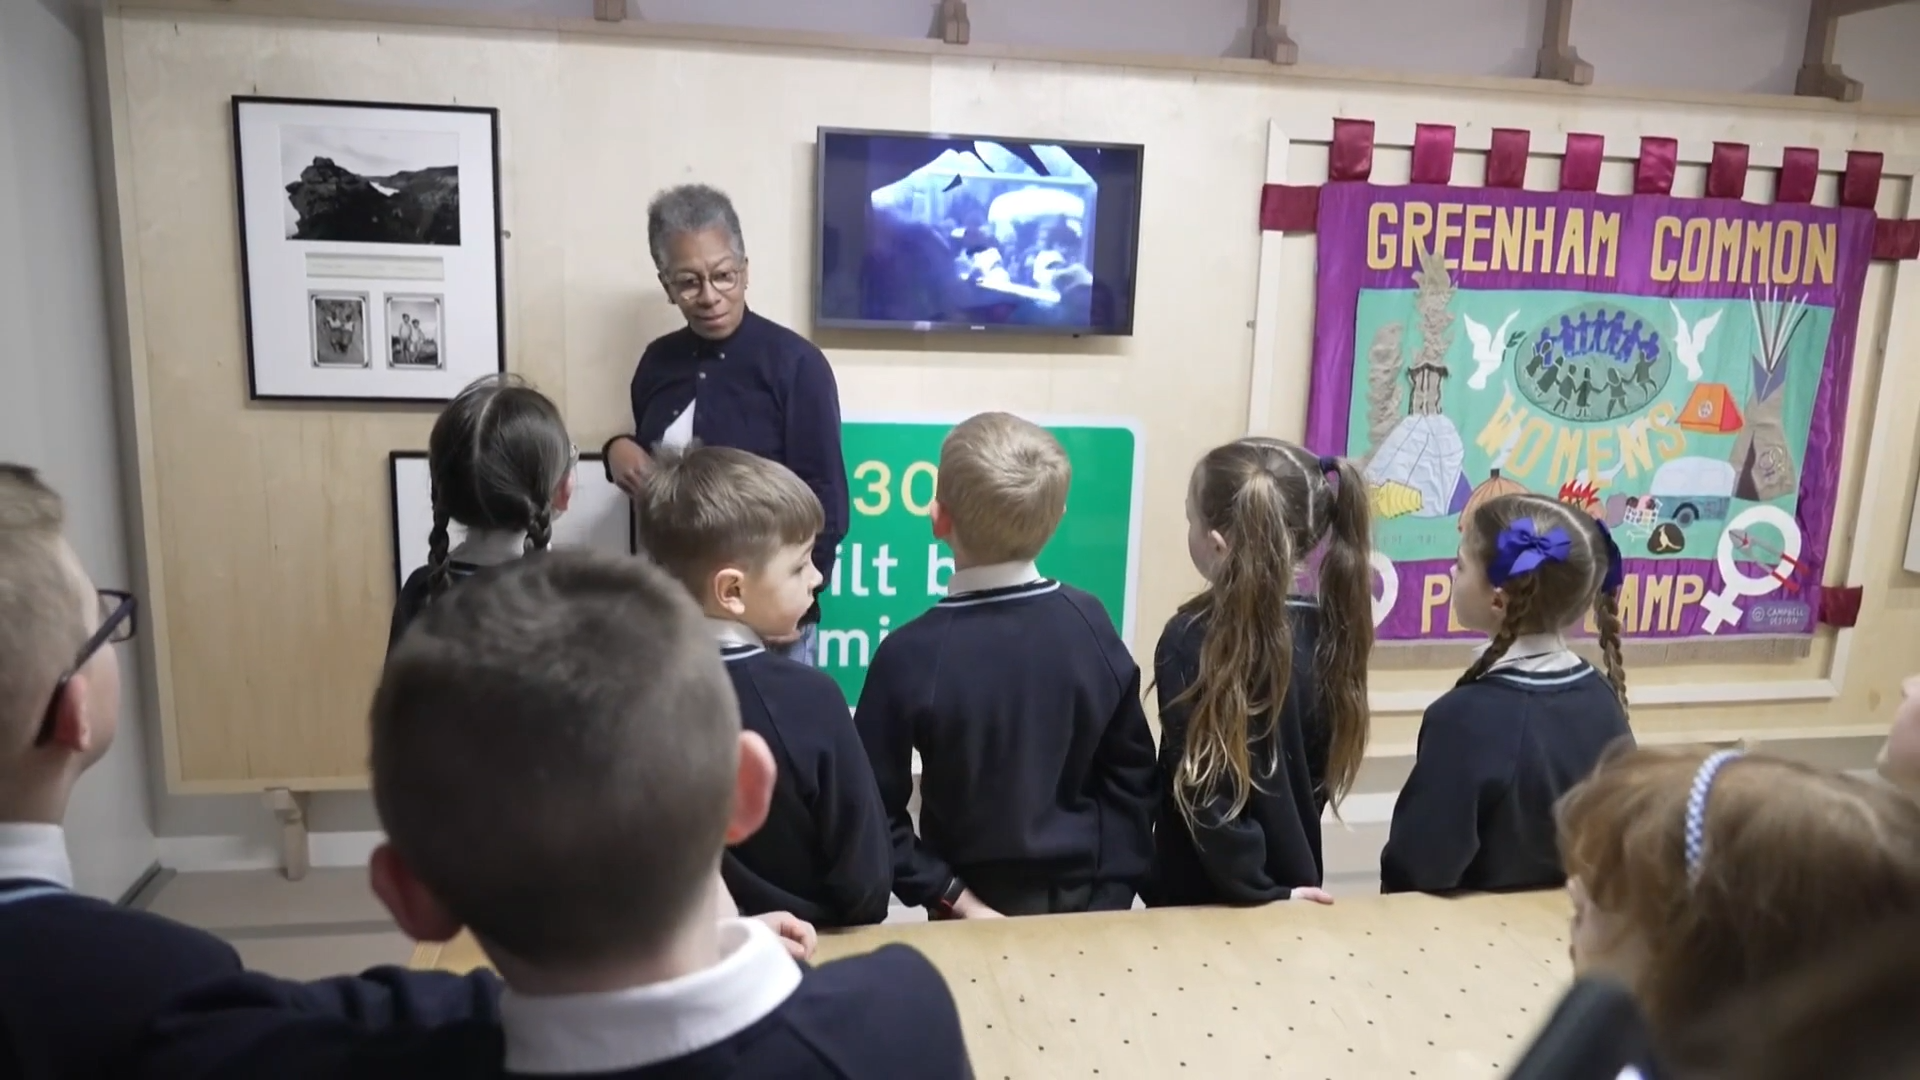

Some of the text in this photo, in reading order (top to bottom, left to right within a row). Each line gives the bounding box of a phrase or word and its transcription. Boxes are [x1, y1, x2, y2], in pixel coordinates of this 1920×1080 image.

[1367, 201, 1837, 284] GREENHAM COMMON
[1475, 394, 1687, 489] WOMENS
[853, 460, 939, 516] 30
[1583, 573, 1704, 633] AMP
